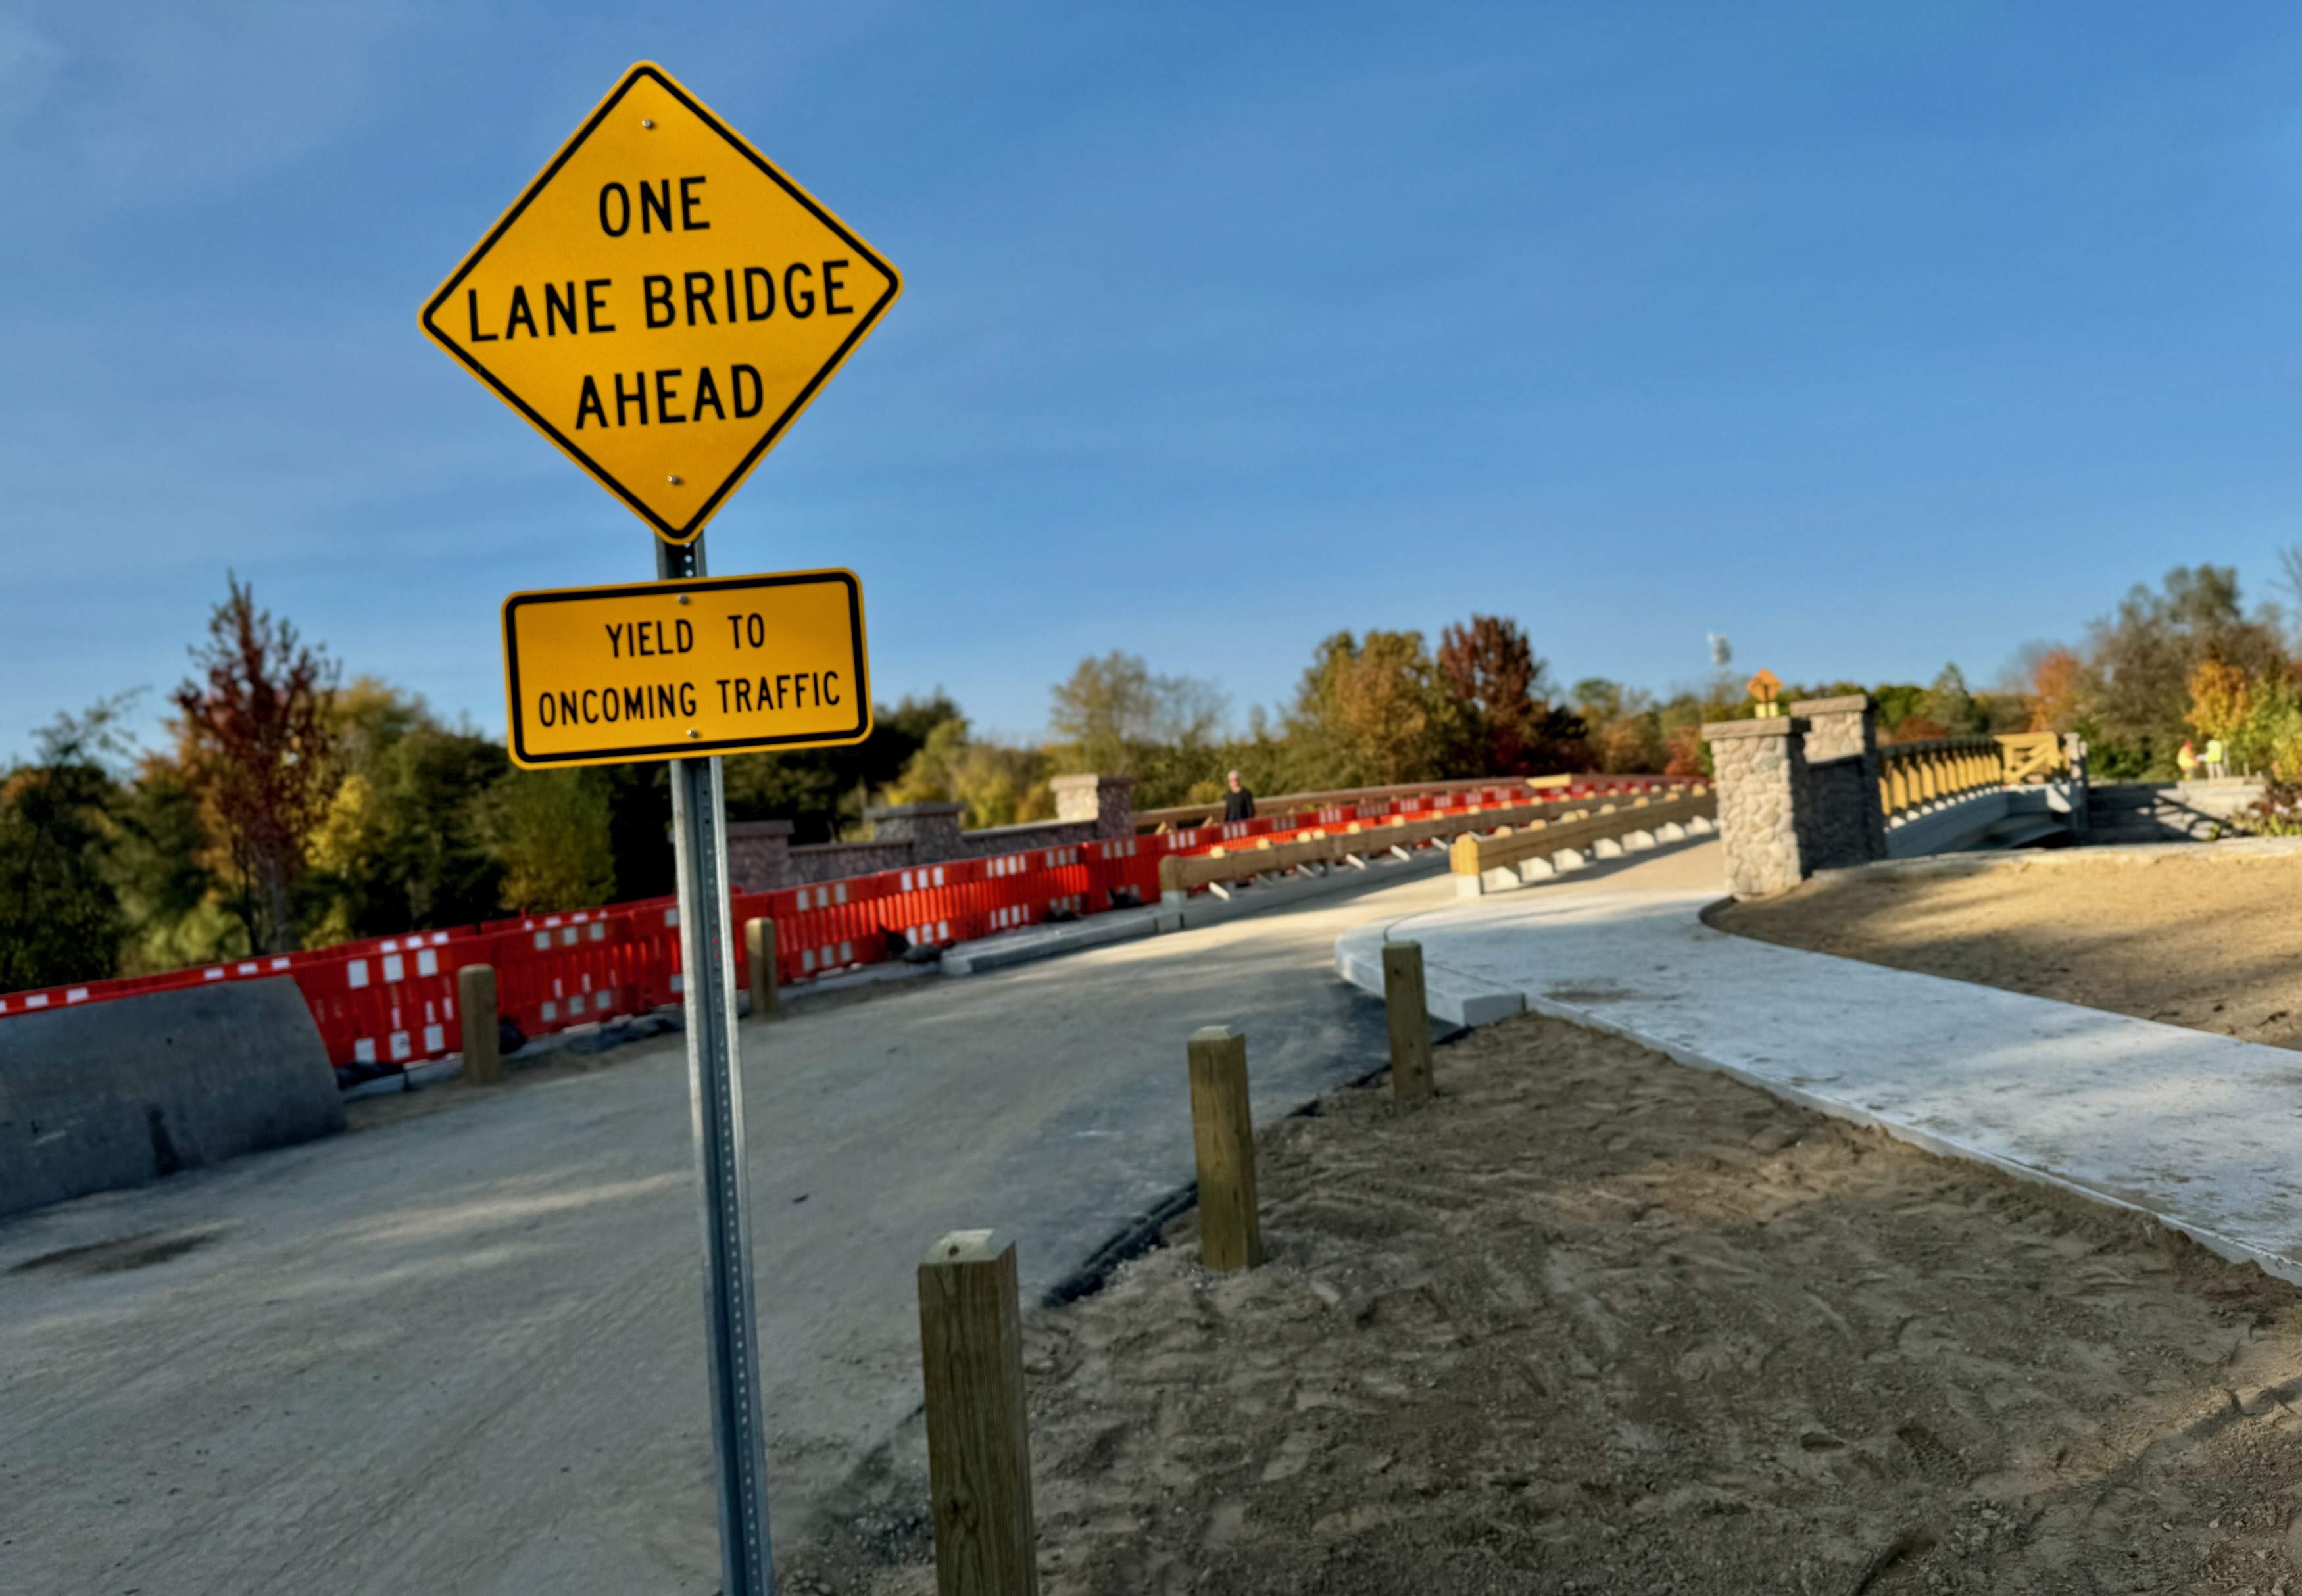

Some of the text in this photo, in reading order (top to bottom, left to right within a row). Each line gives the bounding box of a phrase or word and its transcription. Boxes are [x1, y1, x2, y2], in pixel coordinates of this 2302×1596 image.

[599, 175, 710, 238] ONE
[468, 259, 854, 343] LANE BRIDGE
[575, 364, 764, 430] AHEAD
[606, 612, 766, 658] YIELD TO
[539, 670, 841, 727] ONCOMING TRAFFIC
